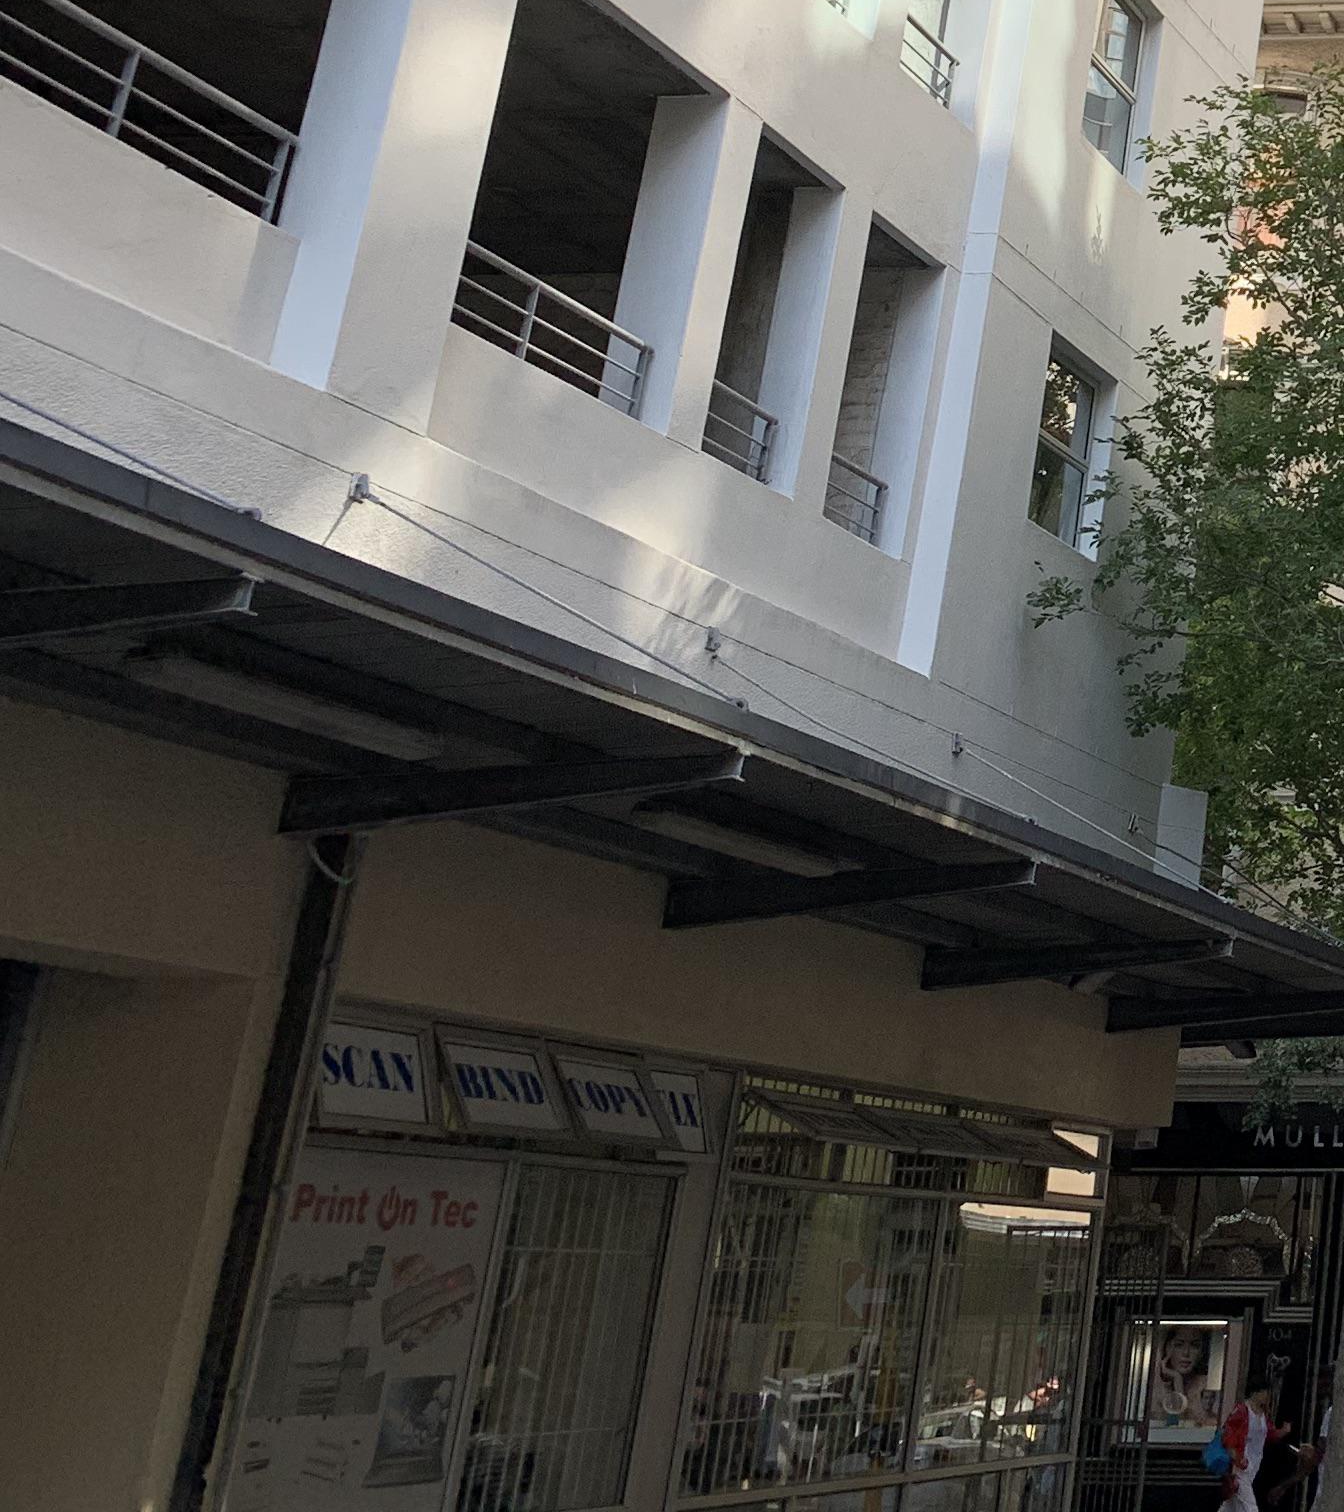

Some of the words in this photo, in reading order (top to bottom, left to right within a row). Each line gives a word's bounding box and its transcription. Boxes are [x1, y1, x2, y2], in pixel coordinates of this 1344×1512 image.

[321, 1042, 414, 1093] SCAN
[455, 1063, 545, 1105] BIND
[566, 1077, 647, 1117] COPY
[656, 1089, 700, 1128] AX
[289, 1184, 369, 1225] Print
[430, 1190, 479, 1228] Tec
